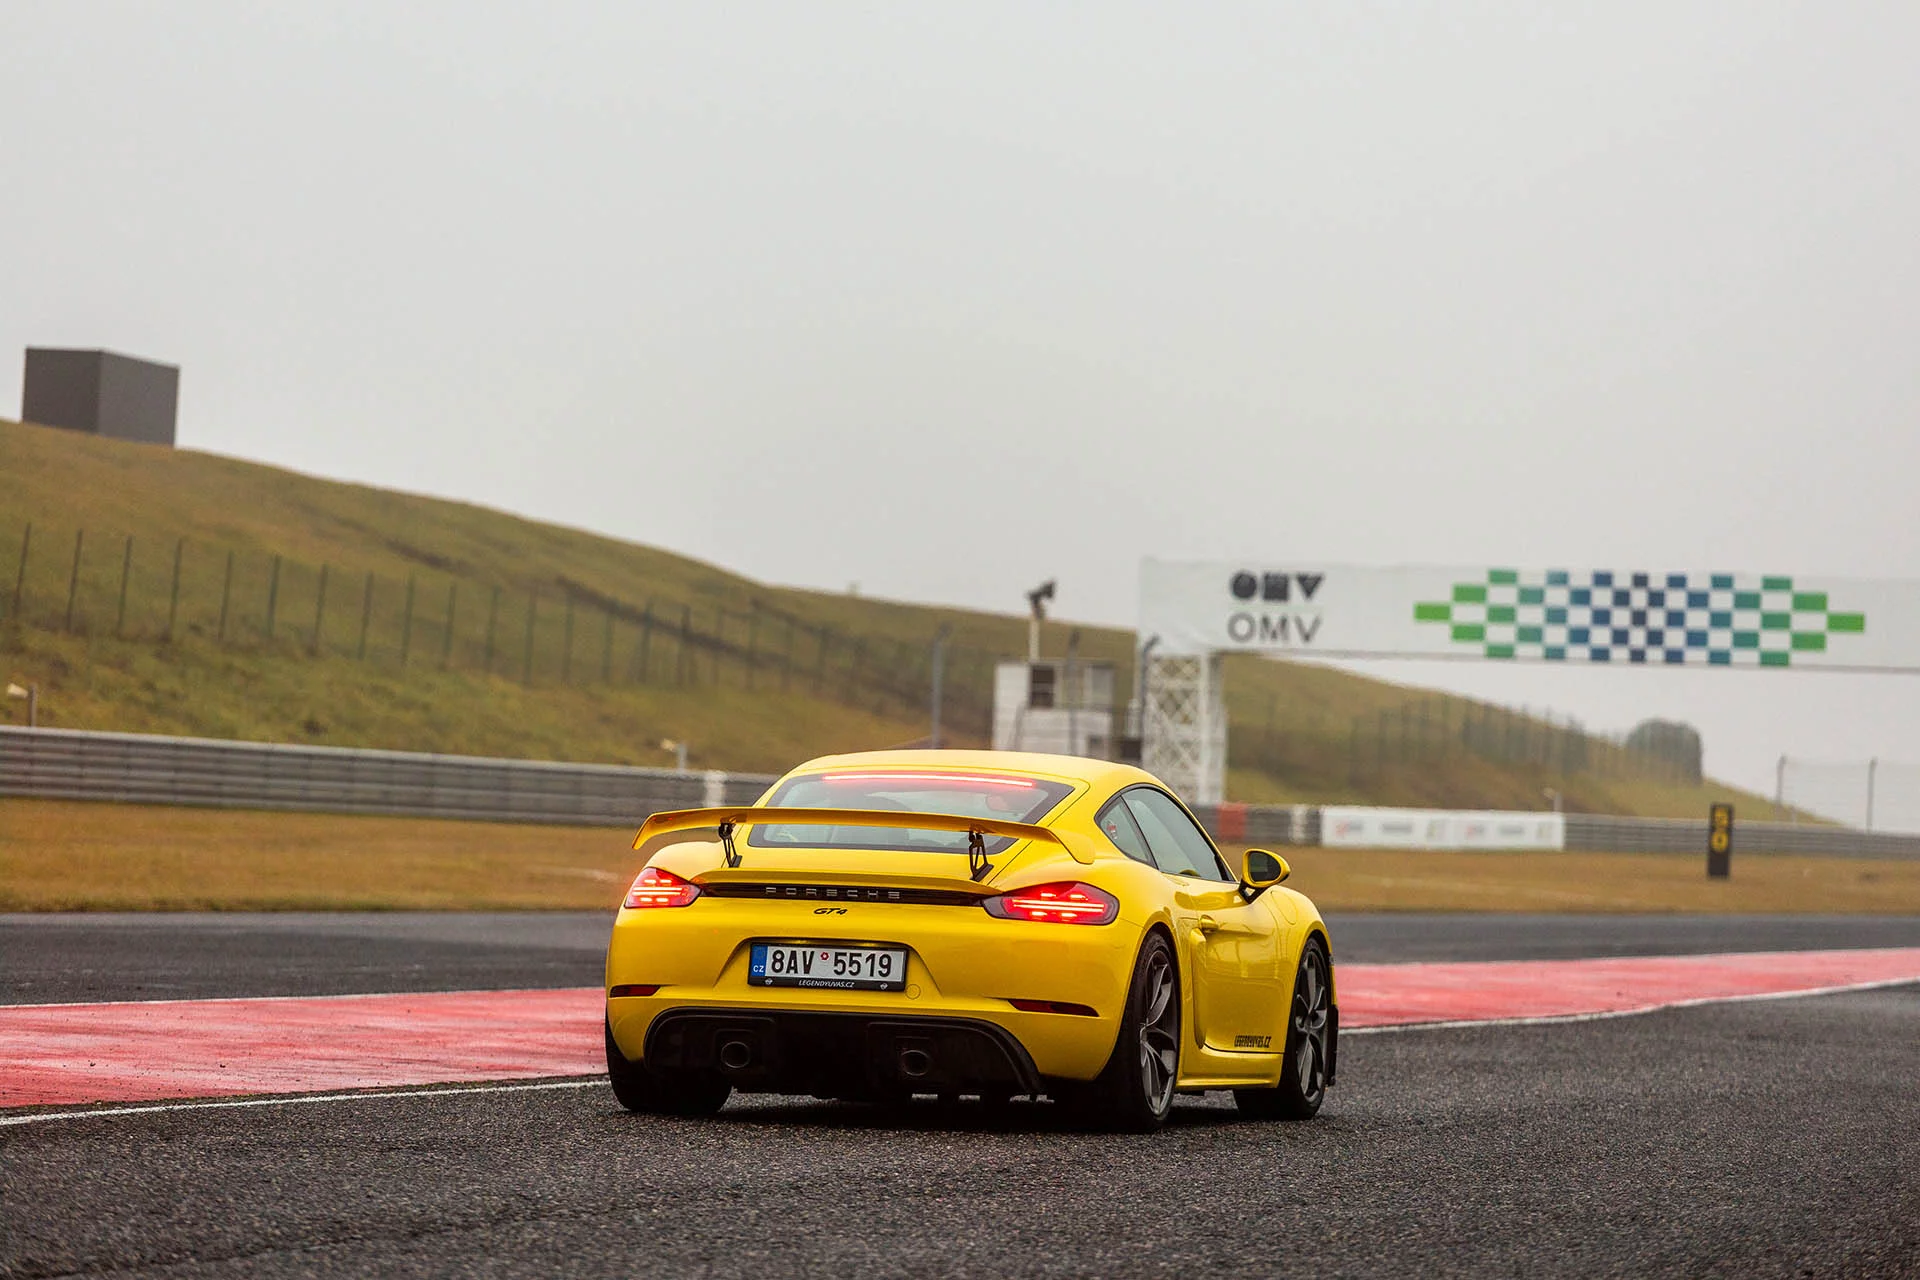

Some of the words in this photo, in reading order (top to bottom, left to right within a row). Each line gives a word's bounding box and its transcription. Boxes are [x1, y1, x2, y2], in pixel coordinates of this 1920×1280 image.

[1228, 613, 1323, 642] OMV
[765, 887, 900, 899] PORSCHE
[813, 907, 848, 915] GT4
[771, 950, 815, 974] 8AV
[833, 952, 892, 977] 5519
[753, 965, 764, 973] CZ
[798, 979, 855, 988] LEGENDYUVAS.CZ
